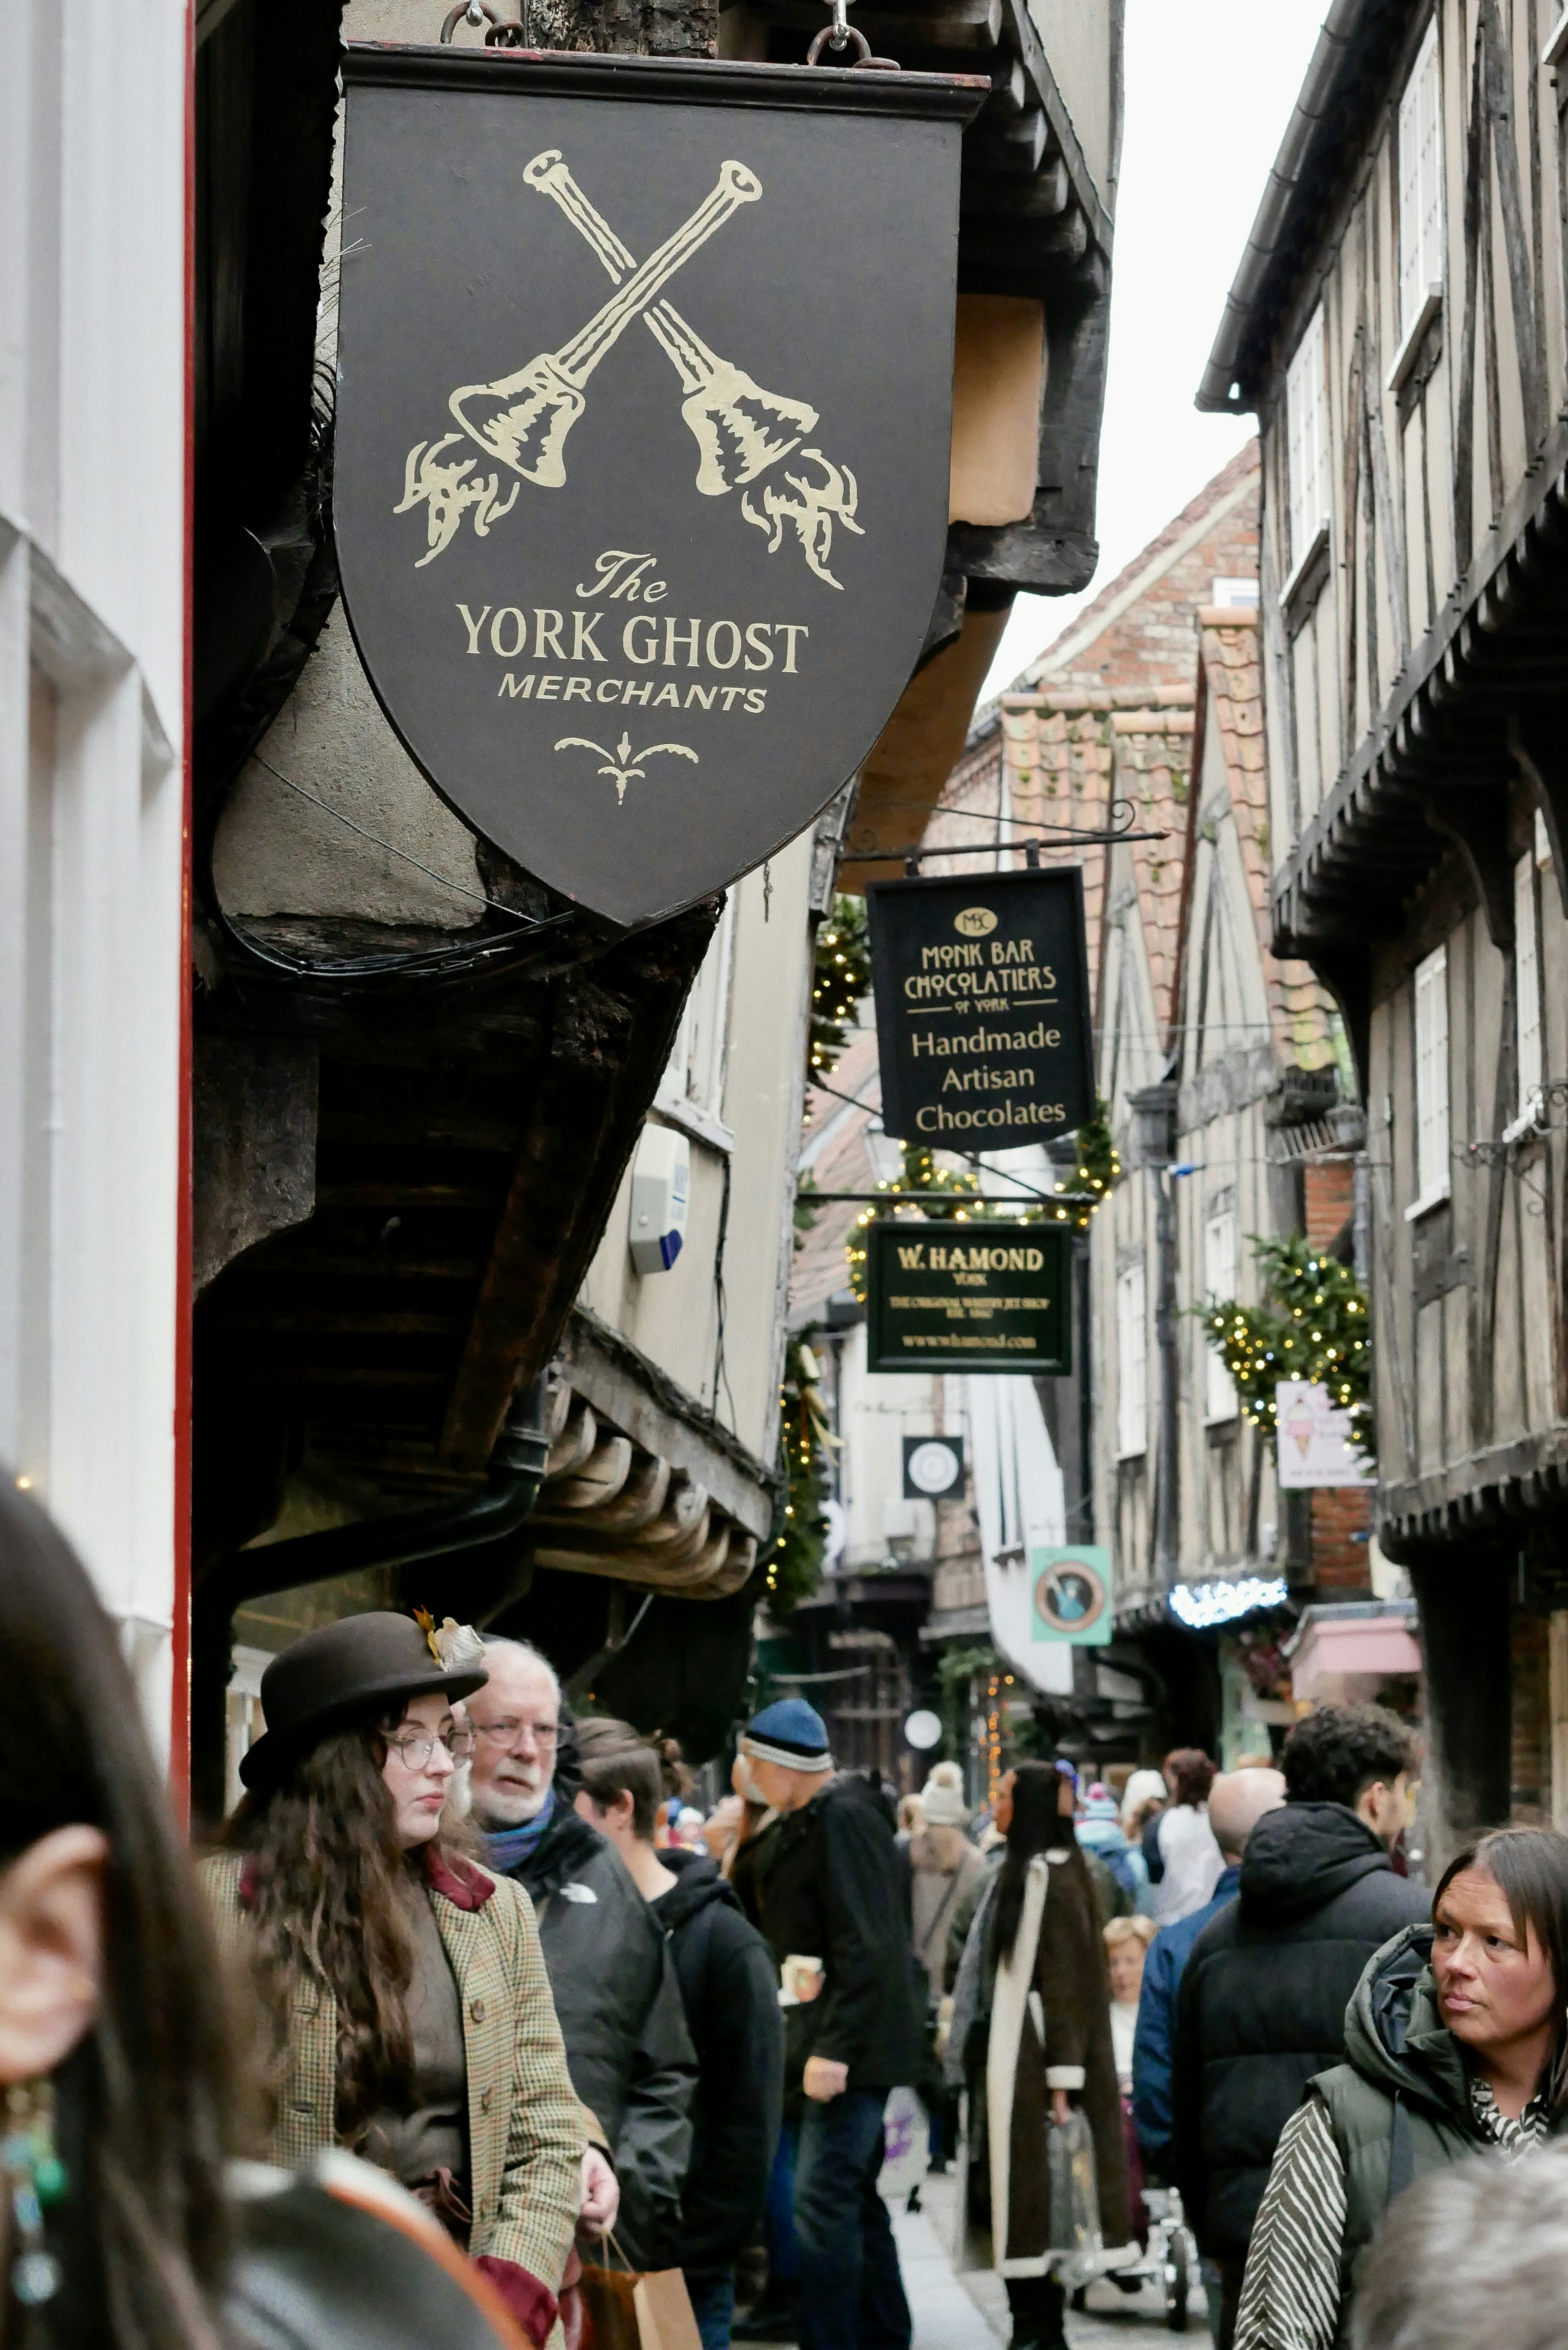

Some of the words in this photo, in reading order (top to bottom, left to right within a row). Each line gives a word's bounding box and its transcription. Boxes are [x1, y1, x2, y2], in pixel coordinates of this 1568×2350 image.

[576, 551, 668, 602] The
[455, 604, 609, 661] YORK
[623, 616, 809, 672] GHOST
[498, 673, 767, 713] MERCHANTS
[922, 944, 983, 969] MONK
[991, 940, 1034, 964] BAR
[905, 966, 1057, 999] CHOCOLATIERS
[974, 998, 1009, 1012] YORK
[912, 1022, 1060, 1056] Handmade
[943, 1065, 1034, 1091] Artisan
[917, 1099, 1066, 1132] Chocolates
